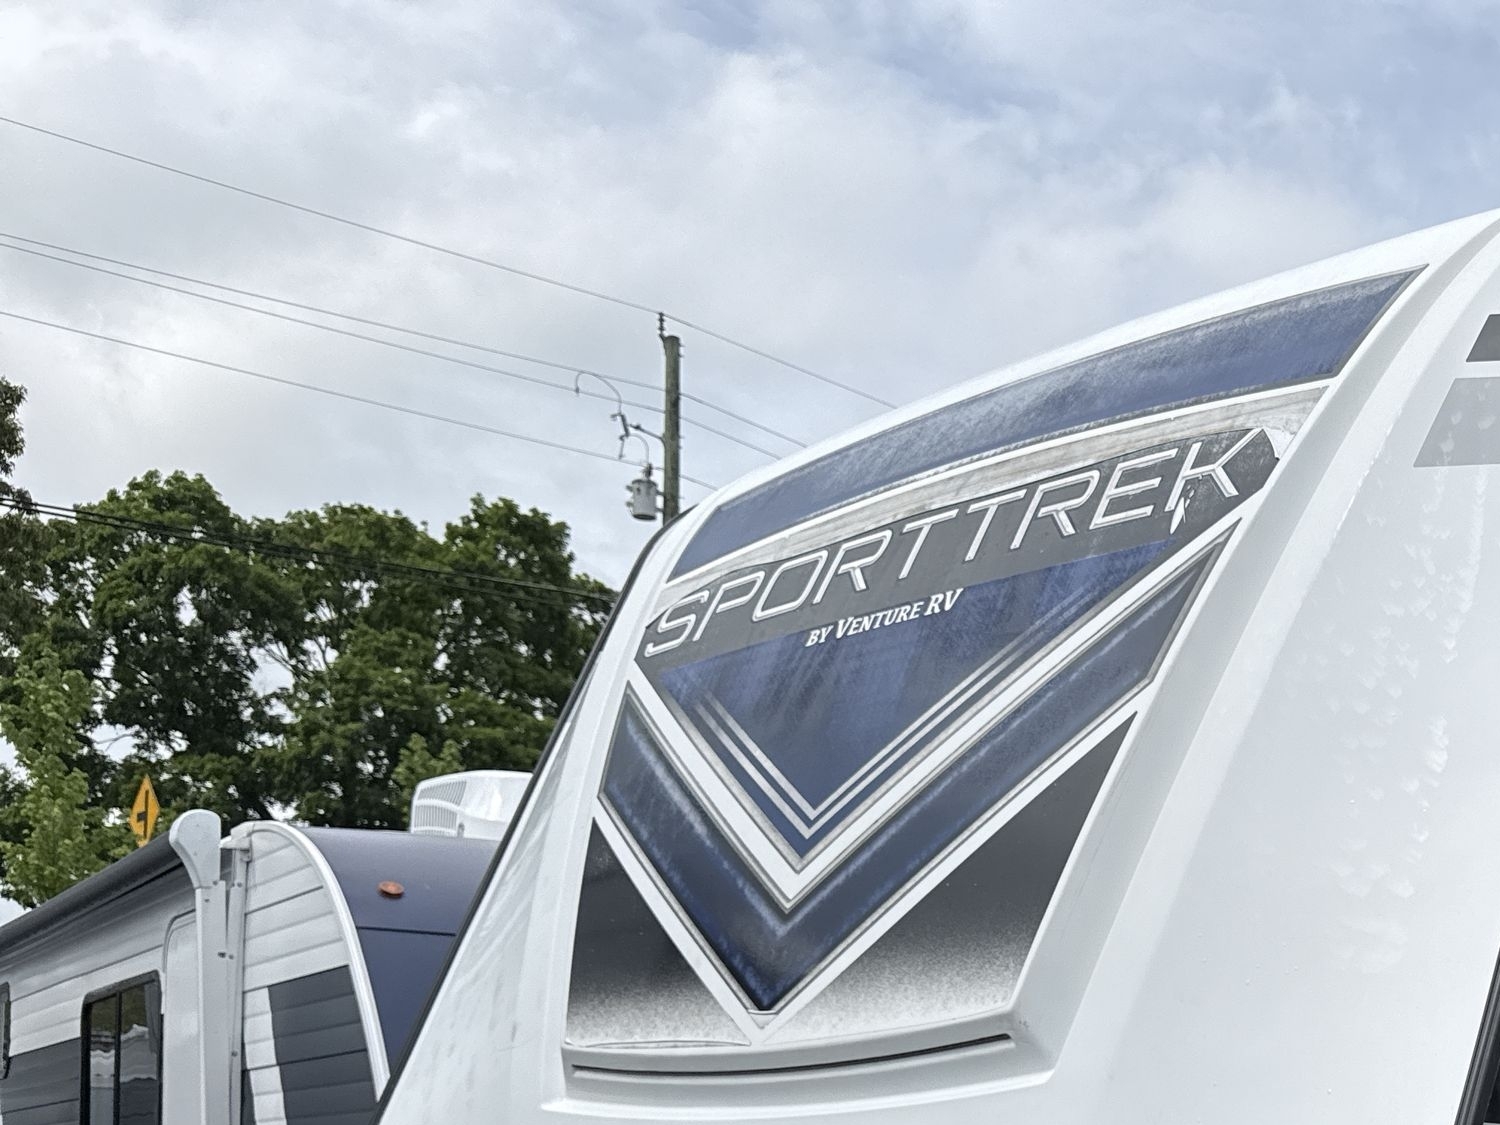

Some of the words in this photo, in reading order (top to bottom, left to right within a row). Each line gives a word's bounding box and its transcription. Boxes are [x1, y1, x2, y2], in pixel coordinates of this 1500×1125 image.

[644, 427, 1263, 658] SPORTTREK
[804, 624, 834, 647] BY
[835, 600, 925, 639] VENTURE
[924, 588, 964, 616] RV
